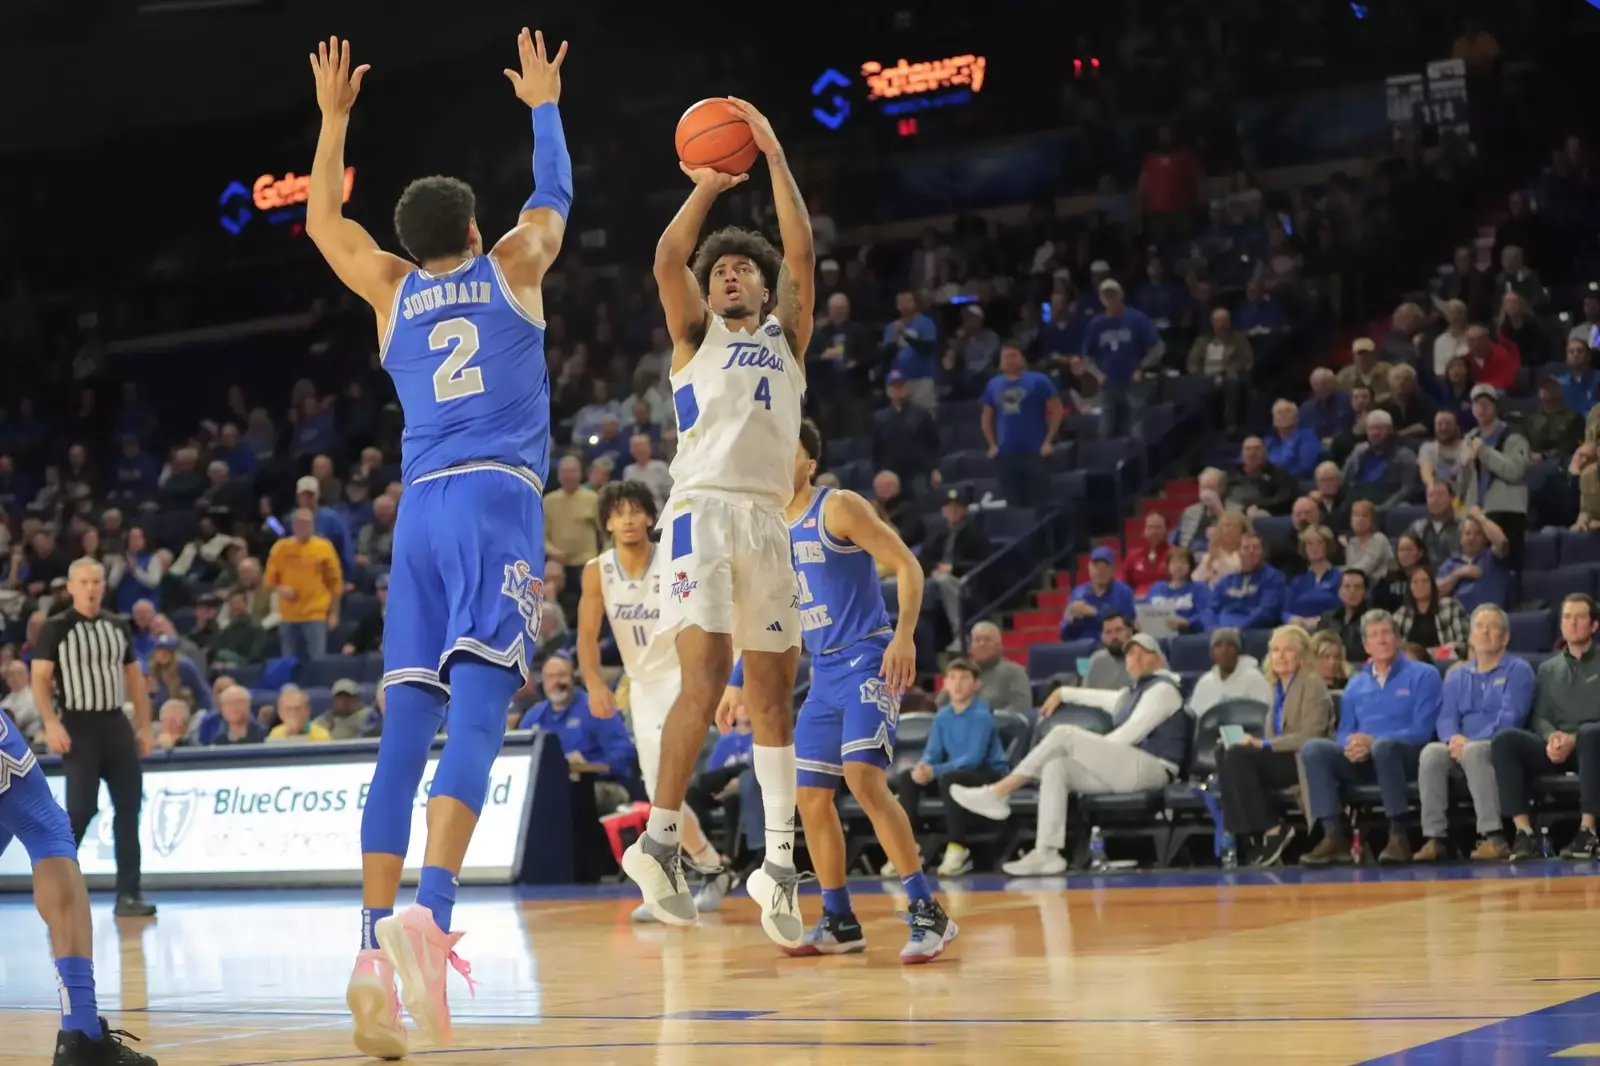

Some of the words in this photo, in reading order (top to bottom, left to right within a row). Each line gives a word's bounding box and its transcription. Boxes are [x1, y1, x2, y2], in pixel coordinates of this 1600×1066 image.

[402, 281, 491, 320] JOURDAIN
[428, 317, 485, 403] 2
[721, 342, 784, 372] Tulsa
[754, 376, 771, 411] 4
[670, 579, 699, 599] Tulsa
[613, 603, 660, 620] Tulsa
[632, 625, 648, 647] 11
[213, 786, 348, 815] BlueCross
